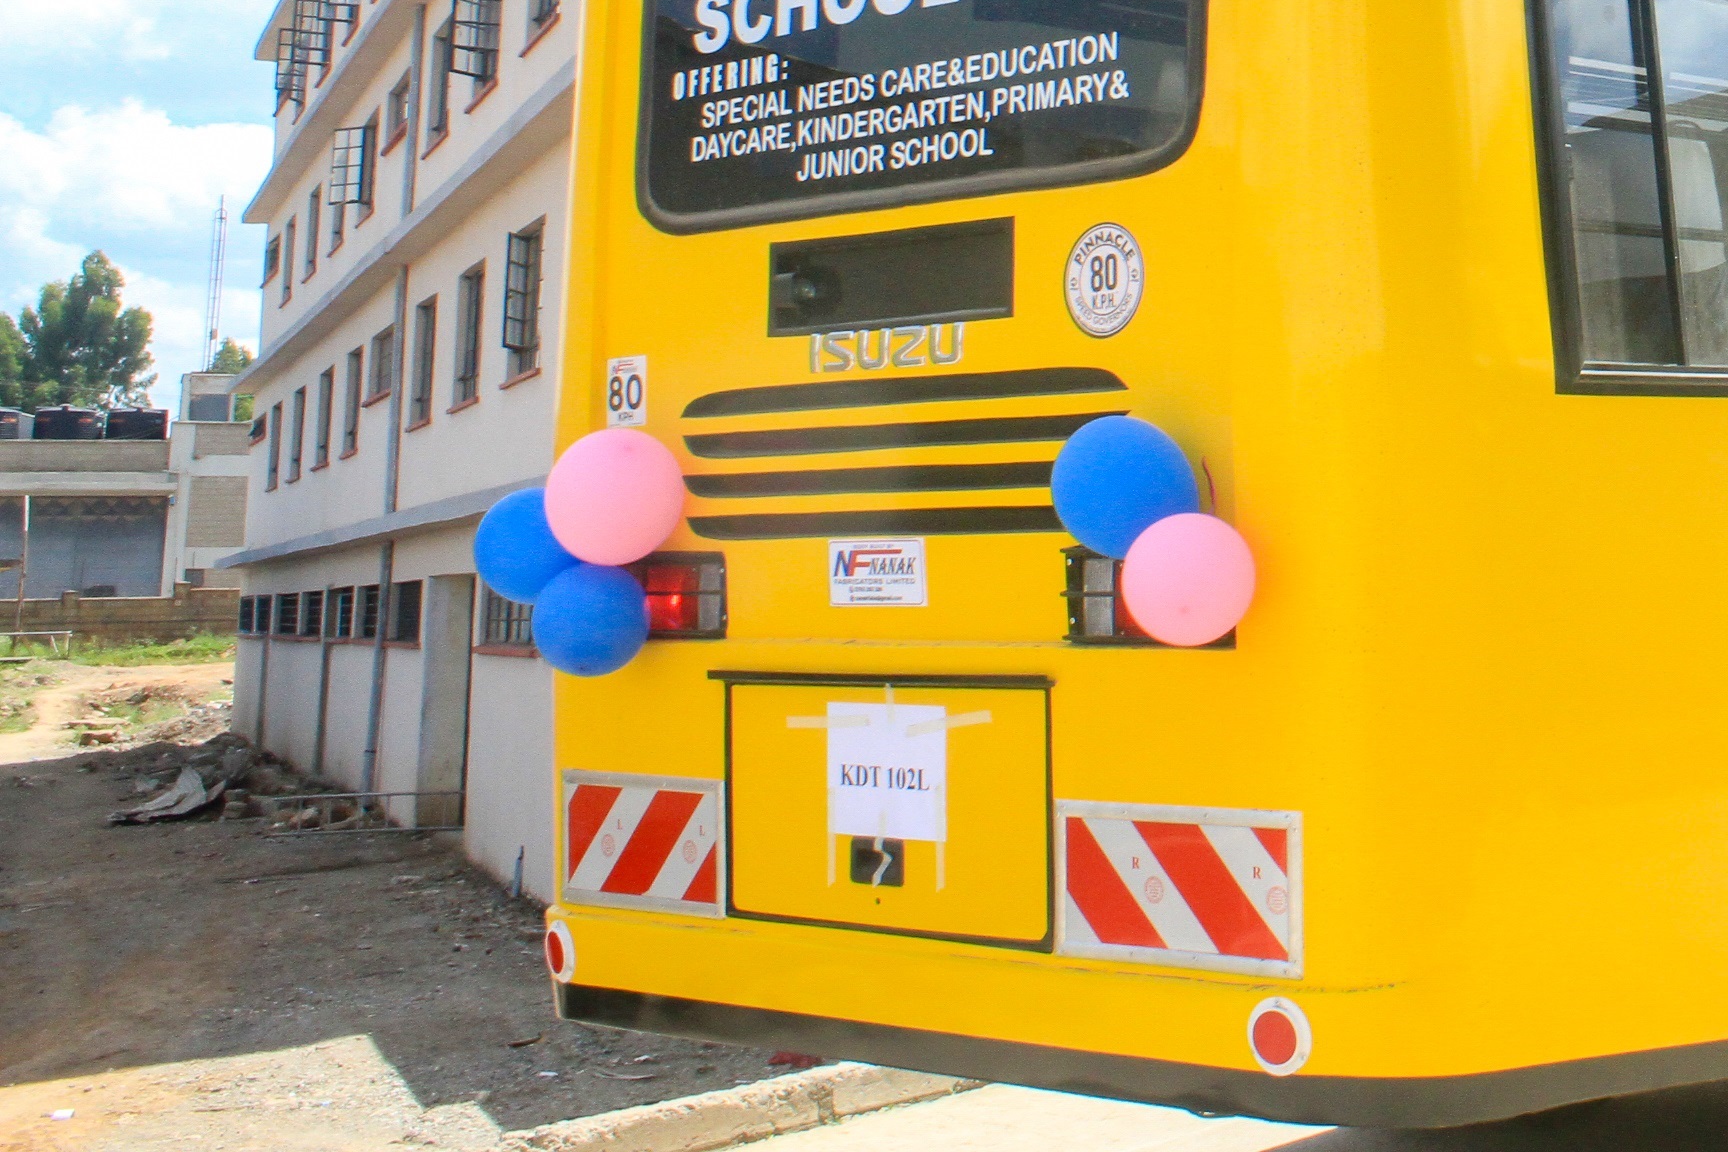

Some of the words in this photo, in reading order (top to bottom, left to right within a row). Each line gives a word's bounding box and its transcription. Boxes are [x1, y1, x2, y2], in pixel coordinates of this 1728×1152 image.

[672, 53, 789, 100] OFFERING:
[700, 89, 792, 128] SPECIAL
[797, 74, 875, 112] NEEDS
[796, 144, 885, 182] JUNIOR
[889, 128, 994, 170] SCHOOL
[1074, 231, 1136, 266] PINNACLE
[1090, 253, 1117, 292] 80
[810, 321, 965, 373] ISUZU
[609, 374, 643, 411] 80
[868, 557, 917, 575] NANAK
[840, 763, 881, 788] KDT
[887, 767, 930, 791] 102L
[1132, 856, 1140, 869] R
[1253, 866, 1262, 879] R
